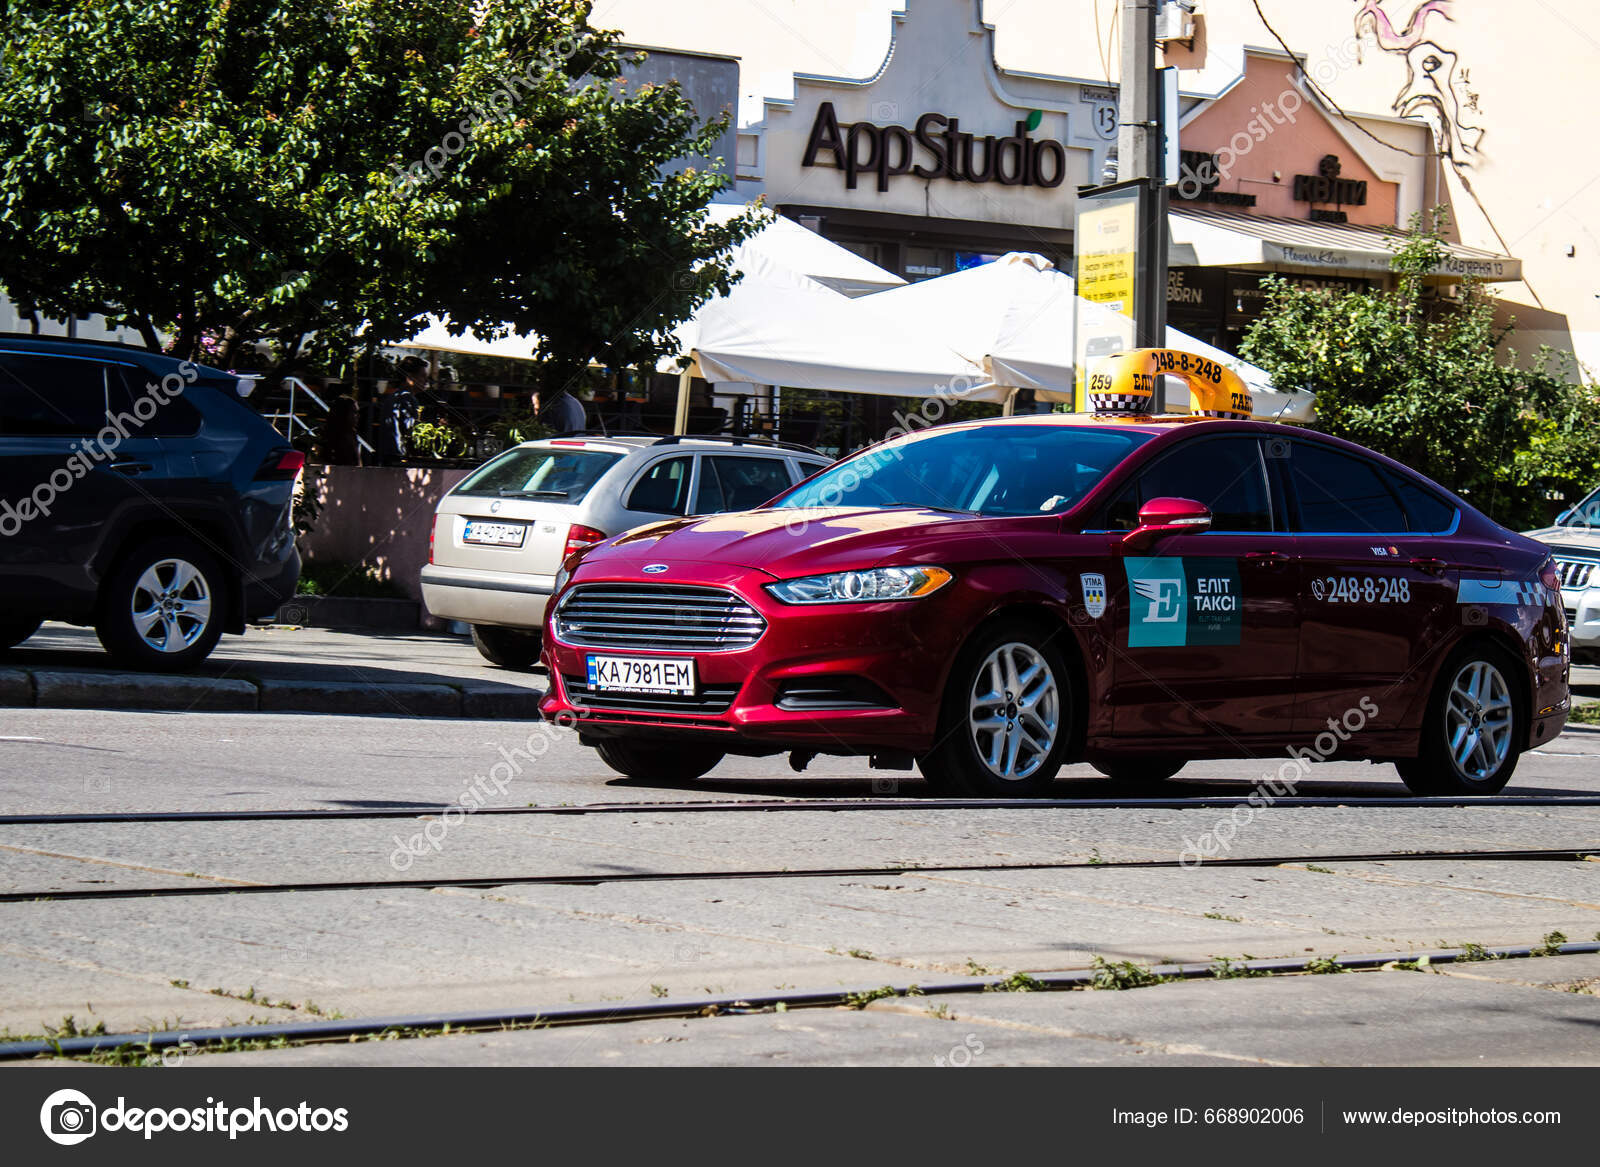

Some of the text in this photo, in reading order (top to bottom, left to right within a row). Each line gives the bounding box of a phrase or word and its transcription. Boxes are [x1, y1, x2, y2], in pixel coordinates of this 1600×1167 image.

[1098, 107, 1116, 133] 13
[802, 102, 1066, 192] AppStudio
[1151, 352, 1222, 384] 248-8-248
[1091, 374, 1112, 390] 259
[1370, 547, 1388, 556] VISA
[1198, 578, 1230, 593] ЕЛІТ
[1326, 577, 1410, 603] 248-8-248
[1194, 595, 1236, 611] ТАКСІ
